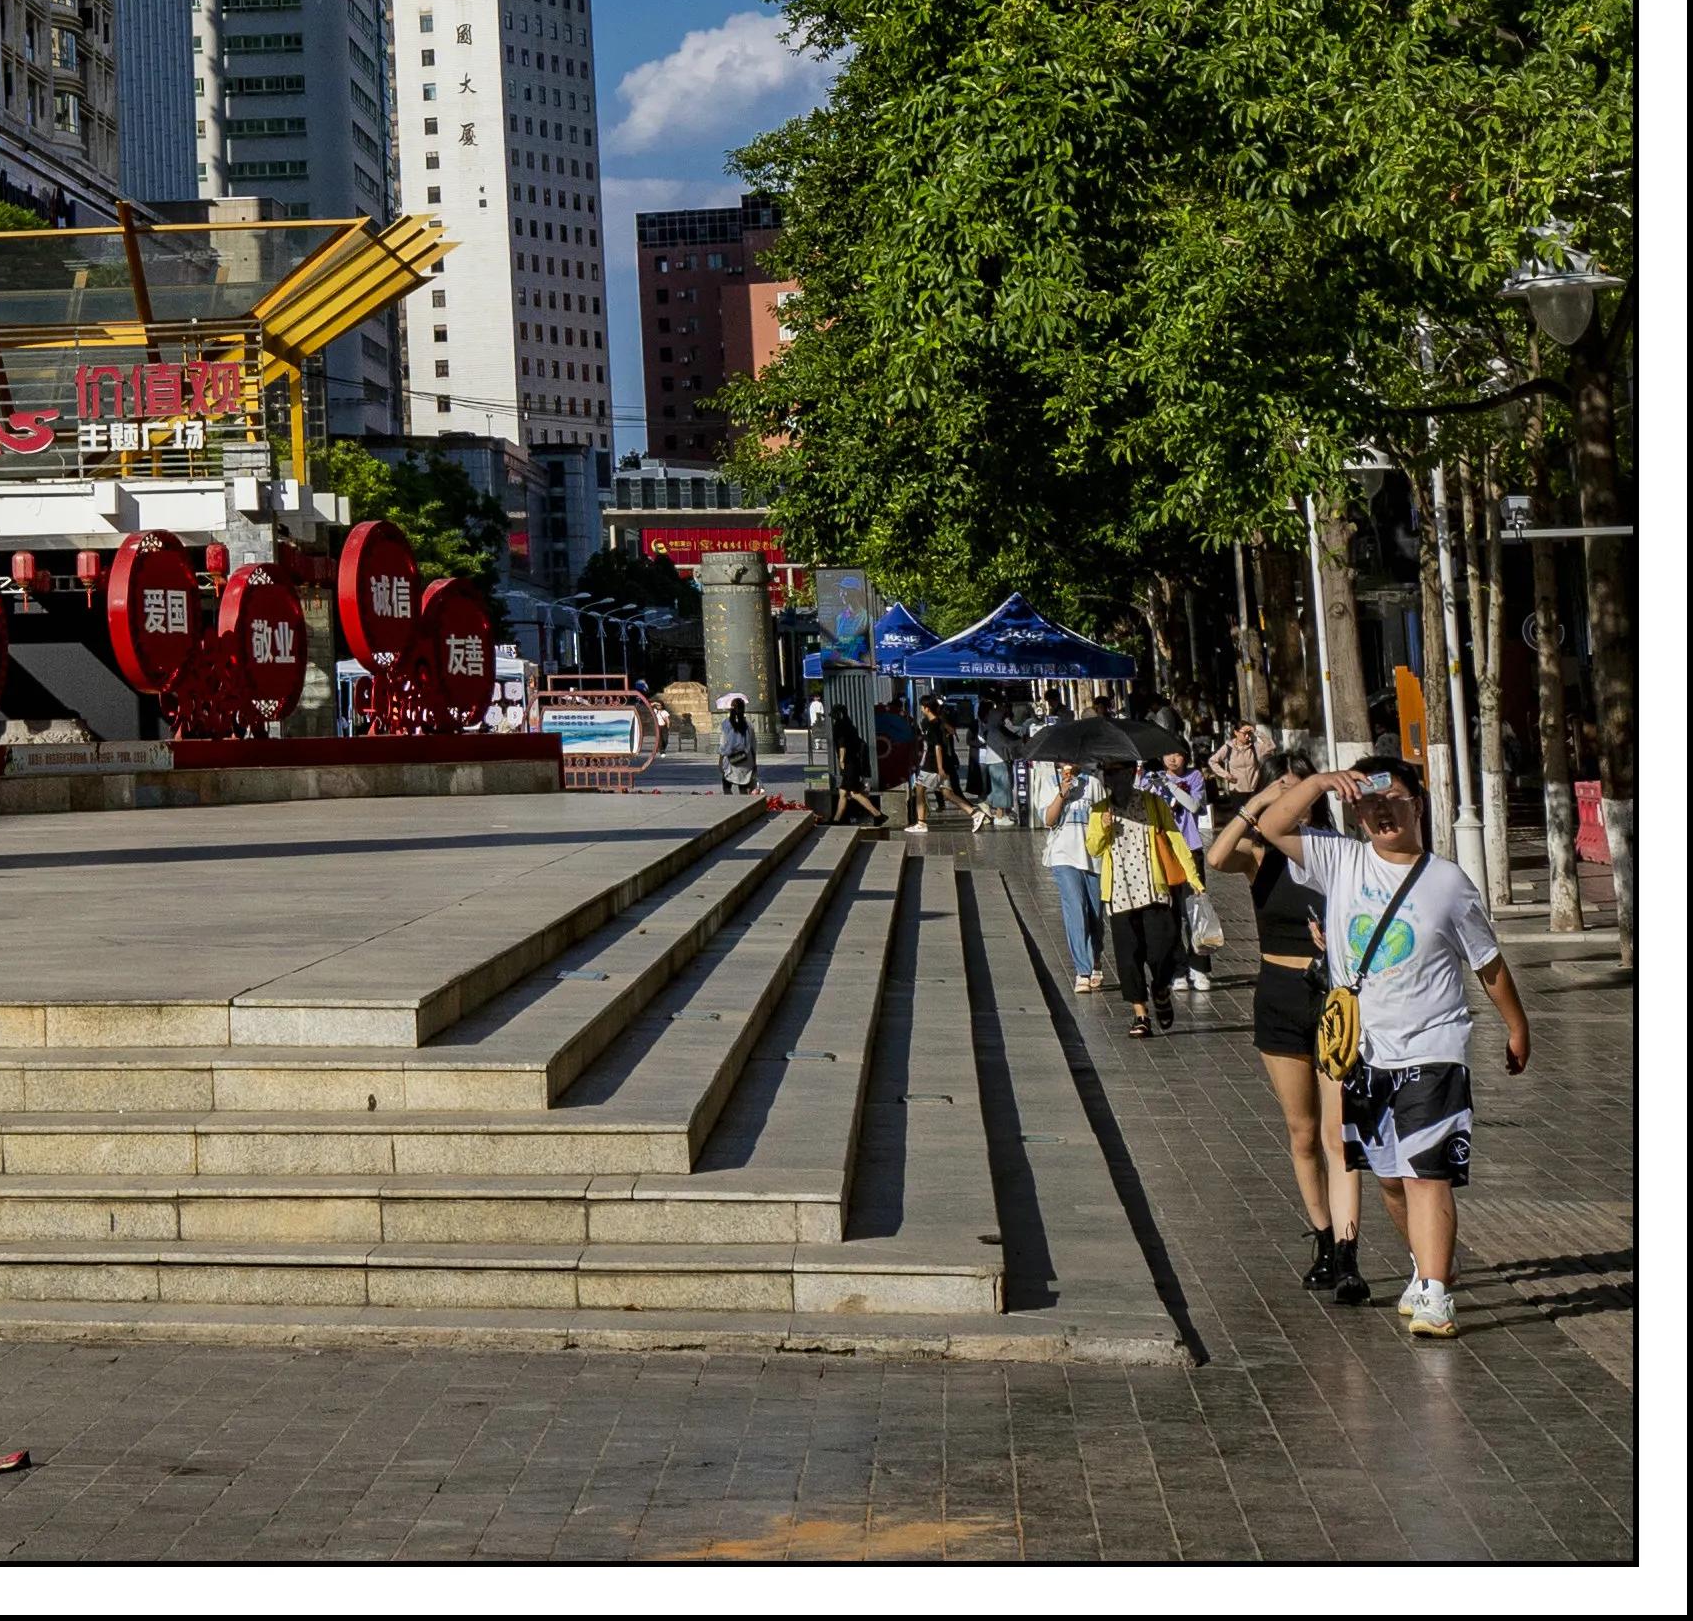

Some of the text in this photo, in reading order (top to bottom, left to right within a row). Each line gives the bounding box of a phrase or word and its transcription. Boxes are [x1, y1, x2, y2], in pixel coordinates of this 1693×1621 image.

[79, 420, 204, 452] 主题广场
[143, 587, 189, 634] 爱国
[369, 575, 413, 619] 诚信
[250, 620, 297, 666] 敬业
[446, 633, 485, 677] 友善
[959, 662, 1081, 675] 云南欧亚乳业有限公司
